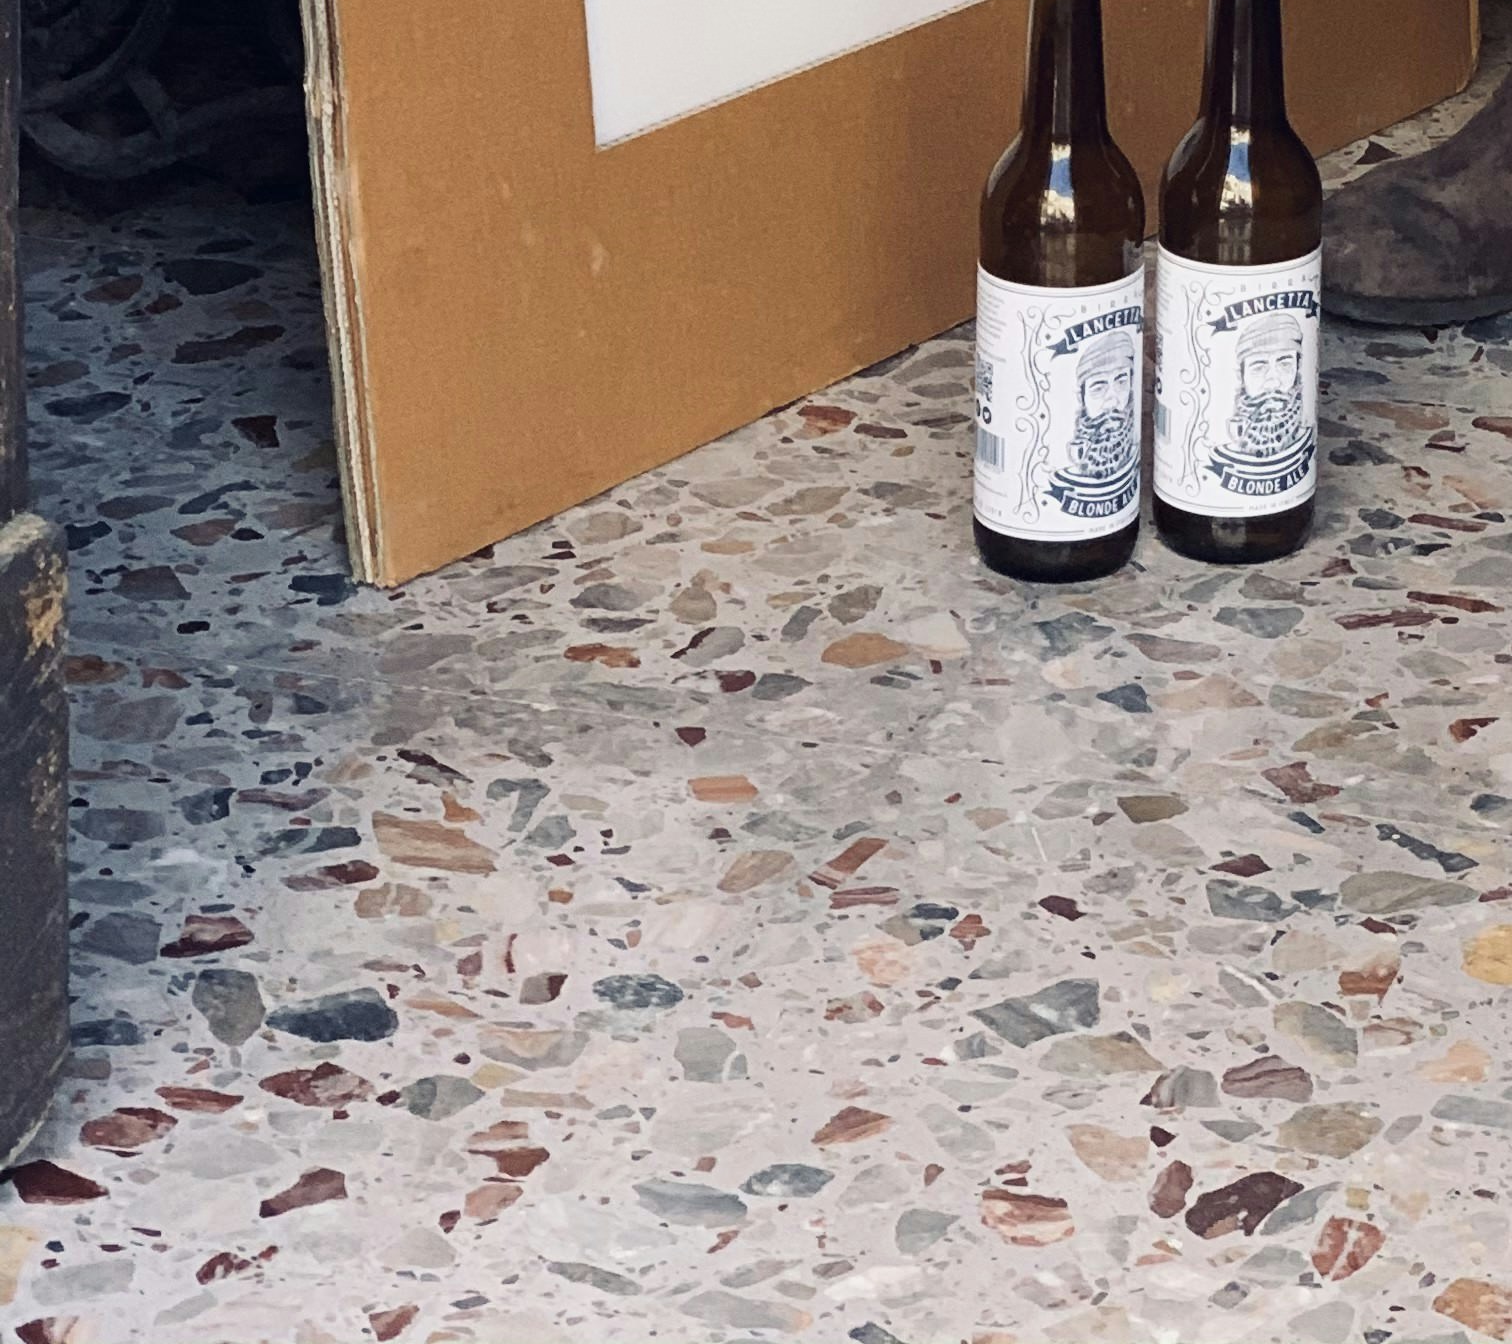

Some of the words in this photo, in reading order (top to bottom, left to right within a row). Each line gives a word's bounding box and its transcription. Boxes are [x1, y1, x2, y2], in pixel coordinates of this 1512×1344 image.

[1229, 292, 1310, 320] LANCETTA
[1227, 475, 1281, 495] BLONDE
[1285, 464, 1305, 489] ALE
[1067, 497, 1119, 517] BLONDE
